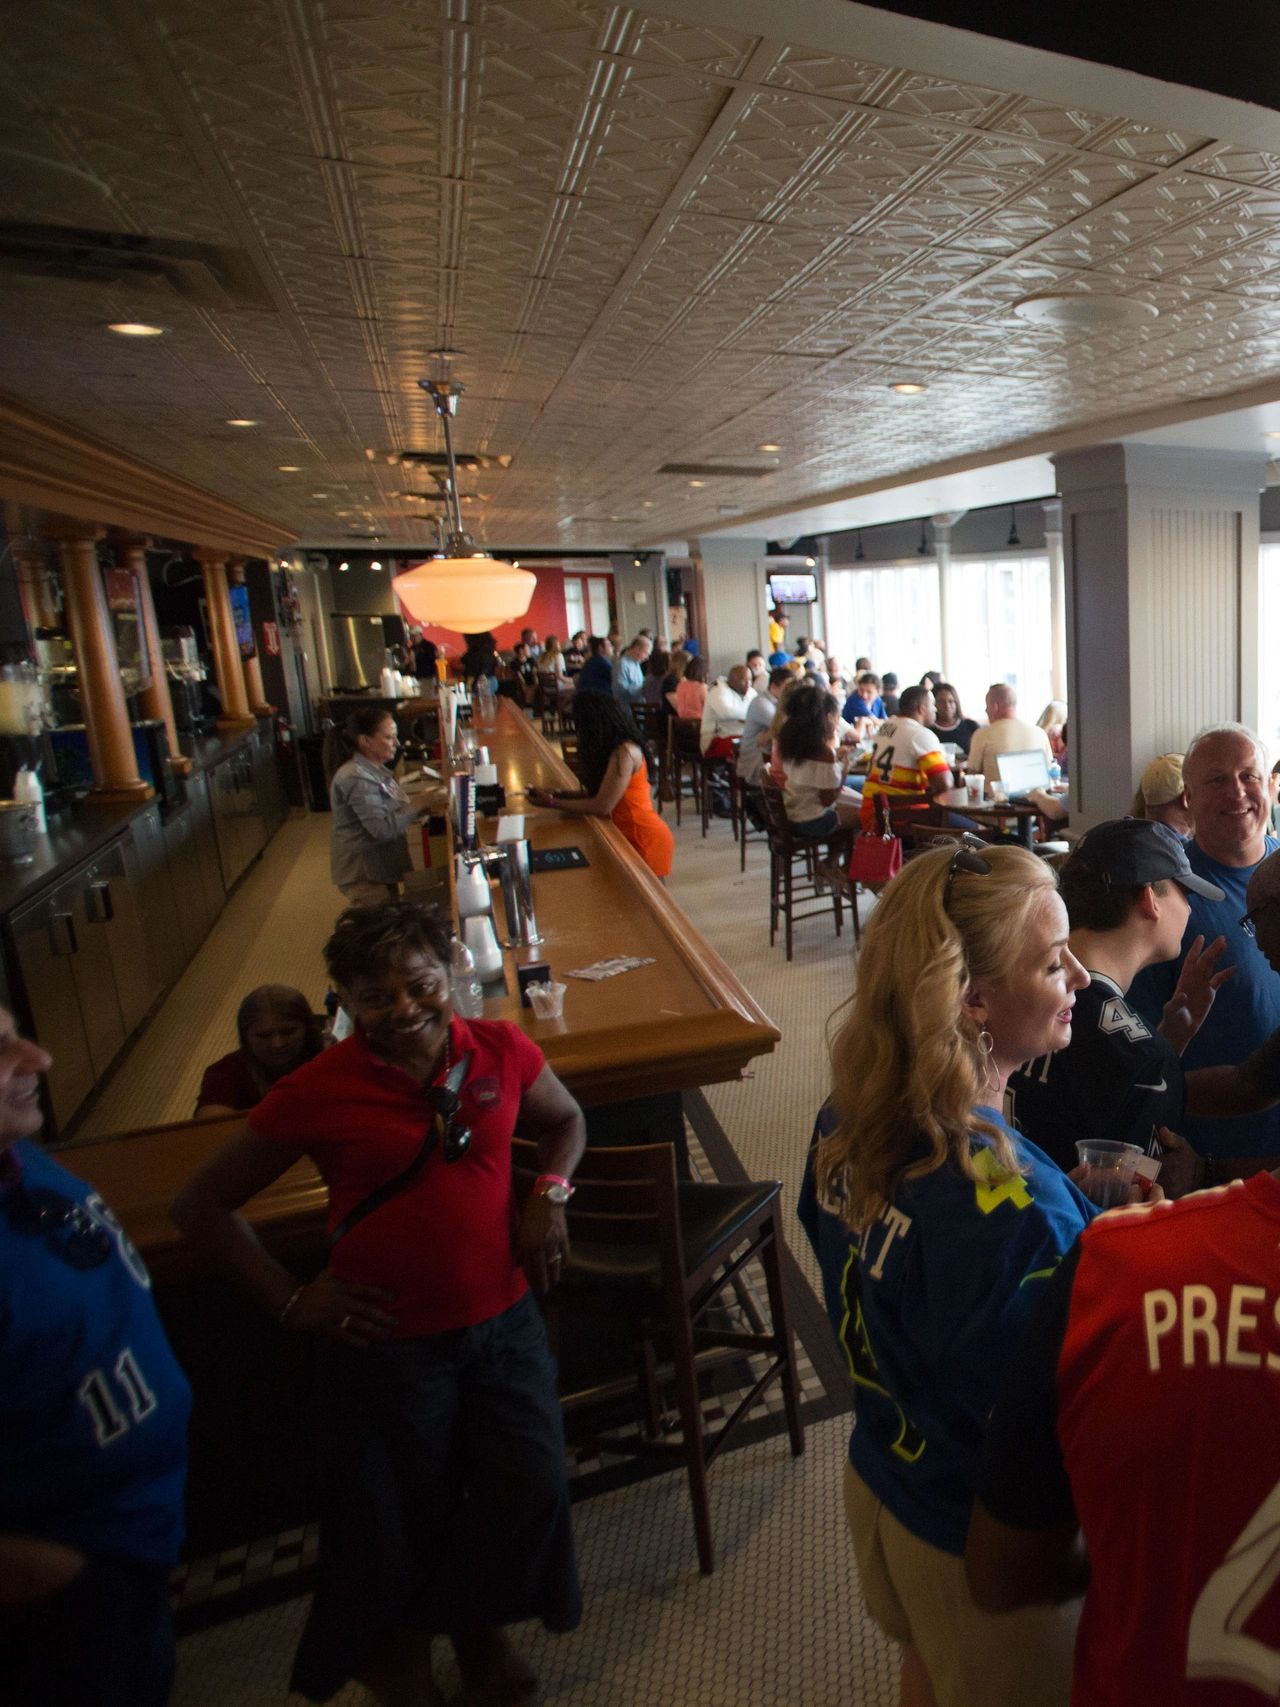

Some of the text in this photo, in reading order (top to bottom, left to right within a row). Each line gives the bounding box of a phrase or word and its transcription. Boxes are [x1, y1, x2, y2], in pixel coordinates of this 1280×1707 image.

[466, 781, 476, 835] BUD LIGHT
[1098, 996, 1152, 1042] 4
[78, 1347, 158, 1448] 11
